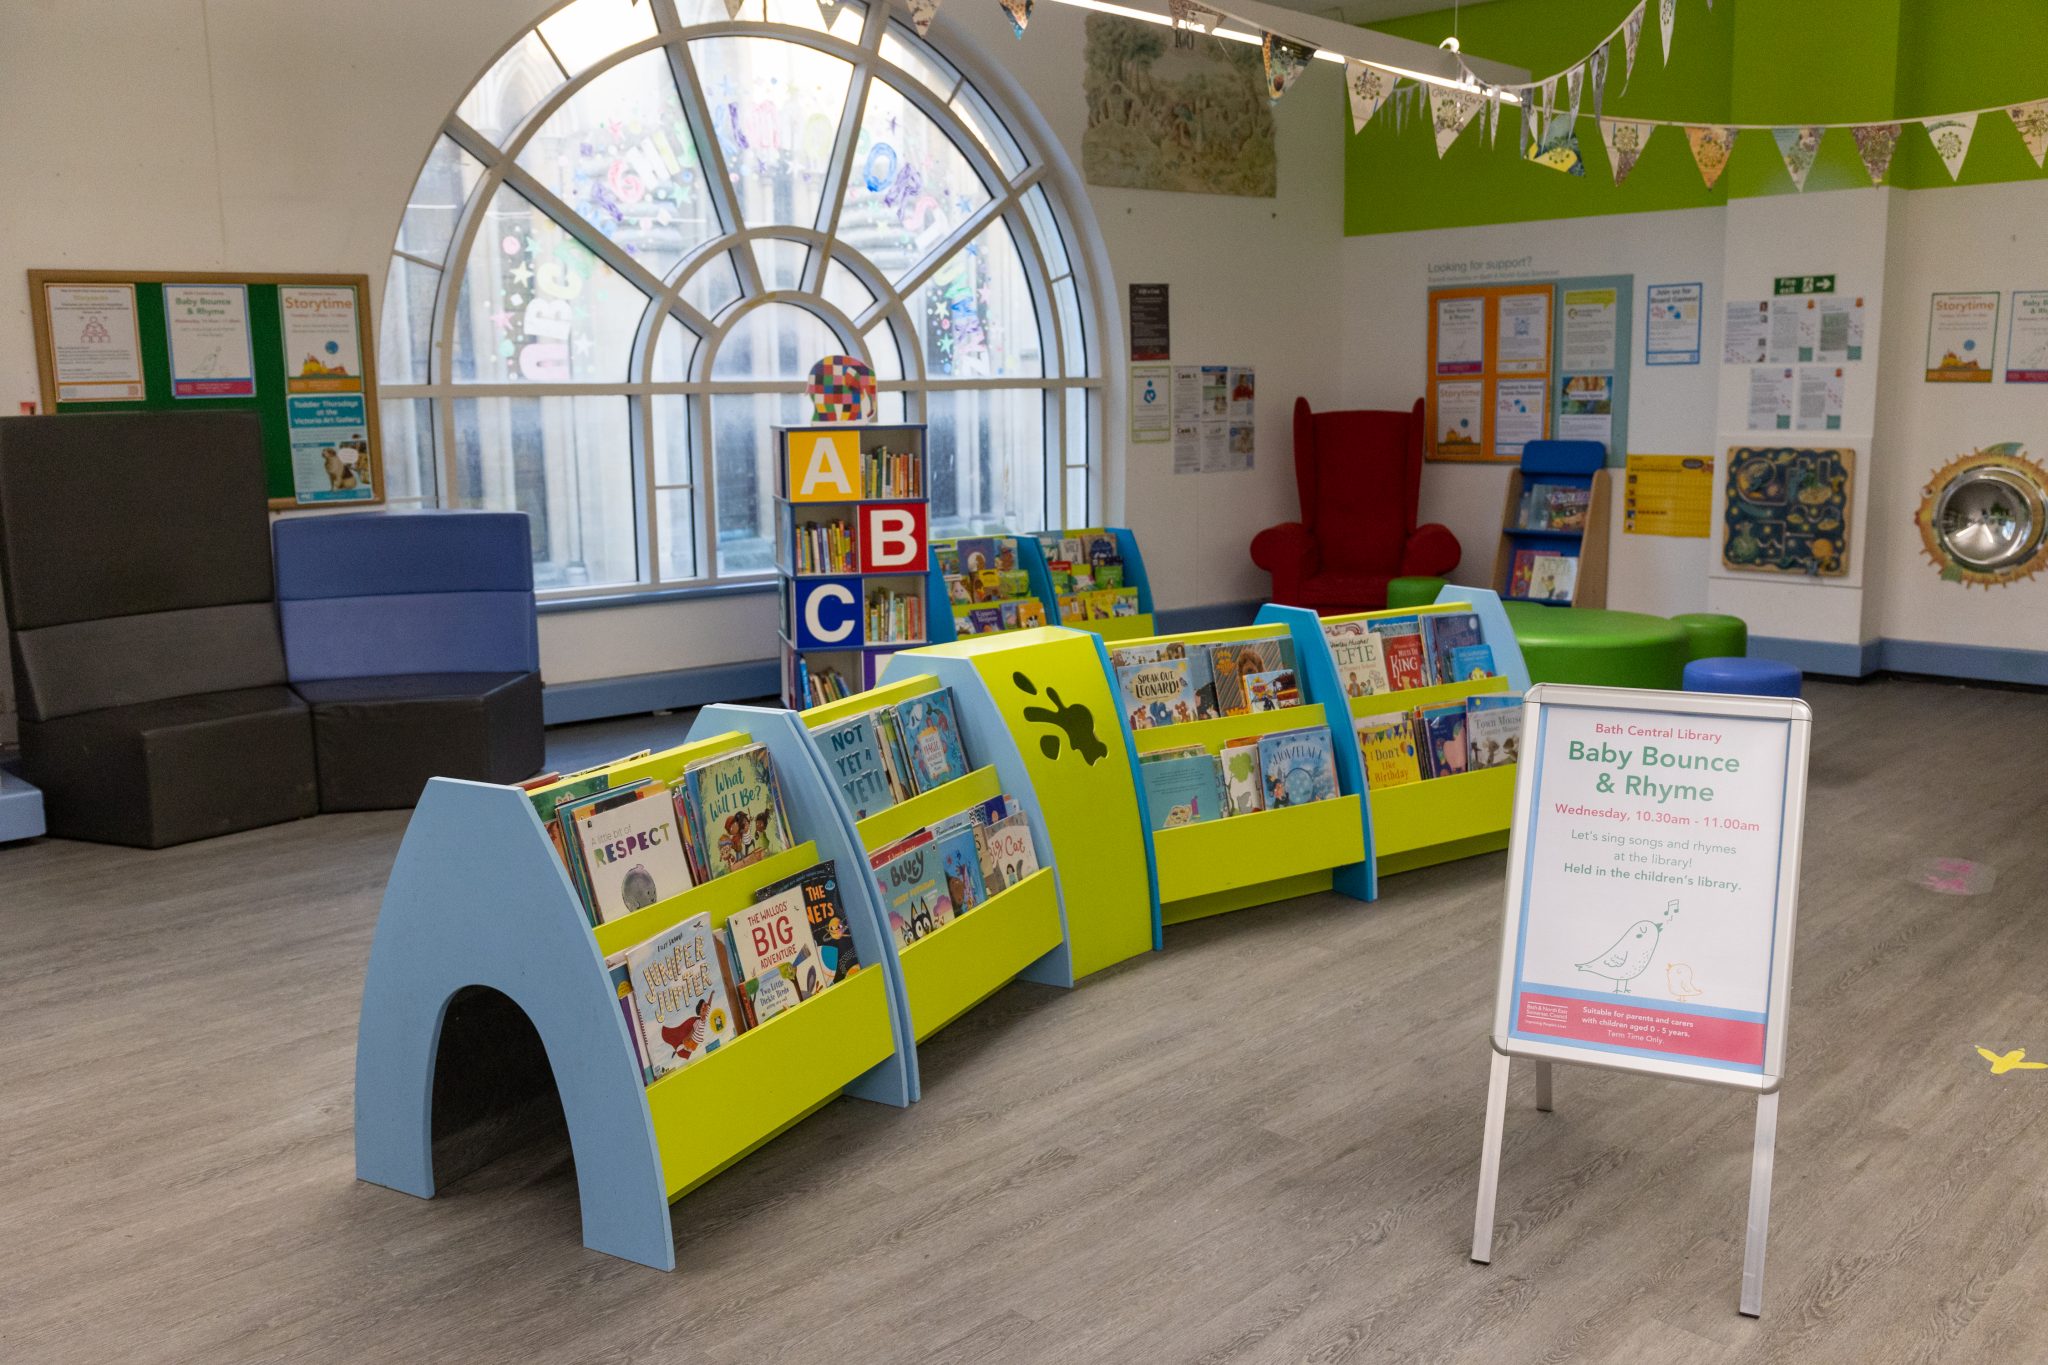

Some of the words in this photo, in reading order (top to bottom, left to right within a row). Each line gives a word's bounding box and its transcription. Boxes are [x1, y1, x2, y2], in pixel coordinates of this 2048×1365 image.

[1427, 262, 1467, 273] Looking
[1470, 260, 1484, 271] for
[1486, 256, 1532, 271] support?
[1780, 278, 1797, 286] Fire
[175, 297, 198, 308] Baby
[200, 297, 231, 305] Bounce
[196, 307, 225, 316] Rhyme
[285, 297, 353, 312] Storytime
[1936, 300, 1995, 313] Storytime
[1439, 389, 1481, 400] Storytime
[800, 437, 852, 495] A
[869, 509, 918, 567] B
[805, 583, 856, 643] C
[1137, 672, 1160, 685] SPEAK
[1160, 671, 1174, 681] OUT
[1390, 655, 1418, 687] KING
[1135, 680, 1180, 698] LEONARD!
[1475, 718, 1496, 729] Town
[1595, 723, 1624, 735] Bath
[1628, 725, 1673, 739] Central
[1677, 728, 1722, 744] Library
[831, 724, 863, 751] NOT
[835, 751, 863, 776] YET
[1375, 747, 1400, 761] Don't
[1568, 740, 1633, 770] Baby
[1642, 745, 1740, 773] Bounce
[714, 768, 746, 796] What
[842, 768, 884, 805] YETI
[1375, 768, 1409, 783] Birthday
[1596, 772, 1615, 793] &
[1625, 775, 1714, 803] Rhyme
[709, 797, 730, 822] Will
[732, 794, 739, 809] I
[740, 785, 762, 805] Be?
[1555, 803, 1631, 822] Wednesday,
[1636, 810, 1690, 826] 10.30am
[1703, 816, 1760, 832] 11.00am
[594, 822, 670, 868] RESPECT
[1005, 835, 1026, 856] Cat
[1571, 829, 1598, 841] Let's
[1601, 832, 1626, 846] sing
[1628, 836, 1664, 850] songs
[1667, 838, 1690, 851] and
[1692, 841, 1737, 856] rhymes
[890, 850, 924, 887] BLUEY
[1613, 852, 1626, 862] at
[1628, 851, 1648, 864] the
[1651, 853, 1693, 869] library!
[1563, 862, 1592, 875] Held
[1596, 865, 1607, 876] in
[1610, 865, 1631, 879] the
[1634, 869, 1695, 886] children's
[1697, 874, 1742, 893] library.
[806, 884, 826, 902] THE
[747, 914, 760, 927] THE
[760, 900, 788, 921] WALLOOS'
[751, 915, 793, 957] BIG
[760, 943, 798, 969] ADVENTURE
[643, 936, 706, 1004] JUNIPER
[655, 962, 712, 1023] JUPITER
[1581, 1016, 1598, 1025] with
[1599, 1017, 1628, 1029] children
[1630, 1022, 1648, 1033] aged
[1650, 1024, 1656, 1032] 0
[1662, 1026, 1667, 1034] 5
[1668, 1028, 1691, 1038] years.
[1582, 1006, 1612, 1018] Suitable
[1613, 1009, 1625, 1019] for
[1626, 1011, 1655, 1025] parents
[1655, 1014, 1670, 1025] and
[1671, 1018, 1694, 1028] carers
[1608, 1030, 1626, 1039] Term
[1627, 1032, 1644, 1041] Time
[1646, 1035, 1665, 1045] Only.
